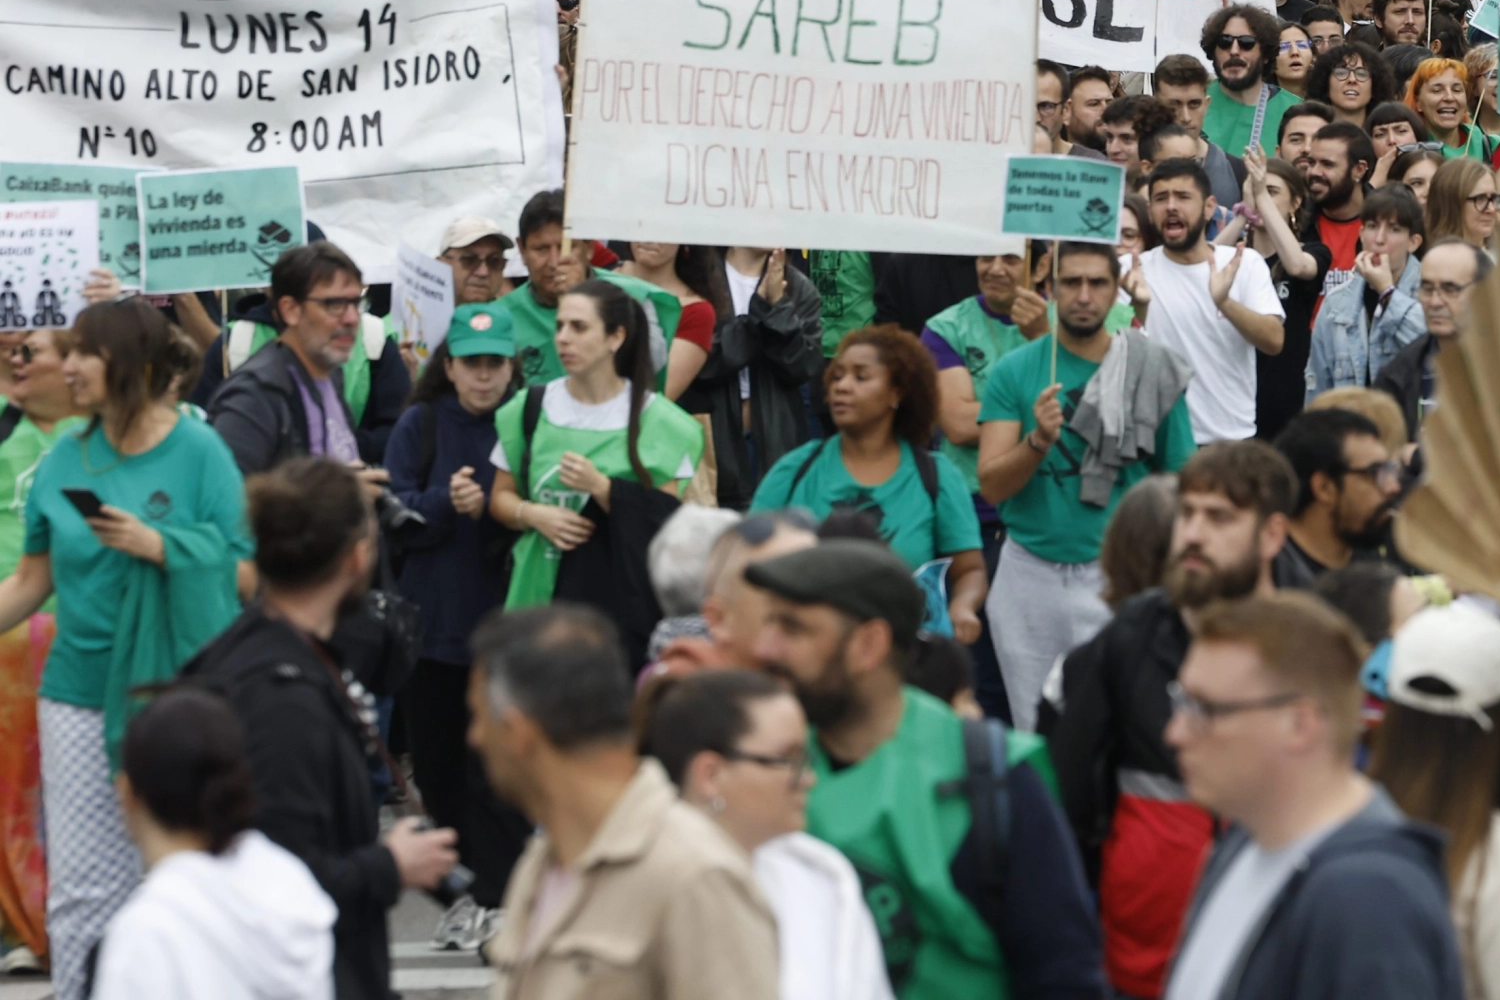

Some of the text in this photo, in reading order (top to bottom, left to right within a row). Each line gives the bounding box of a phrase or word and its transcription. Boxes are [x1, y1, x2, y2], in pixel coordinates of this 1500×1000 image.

[180, 3, 398, 53] LUNES 14
[5, 64, 358, 101] CAMINO ALTO DE SAN
[580, 58, 1028, 145] POR EL DERECHO A UNA VIVIENDA
[6, 175, 93, 194] CaixaBank
[664, 142, 942, 220] DIGNA EN MADRID
[1011, 169, 1062, 181] Tenemos
[148, 190, 223, 211] La ley de
[1008, 184, 1081, 198] de todas las
[1007, 202, 1054, 214] puertas
[148, 216, 245, 235] vivienda es
[150, 238, 248, 260] una mierda
